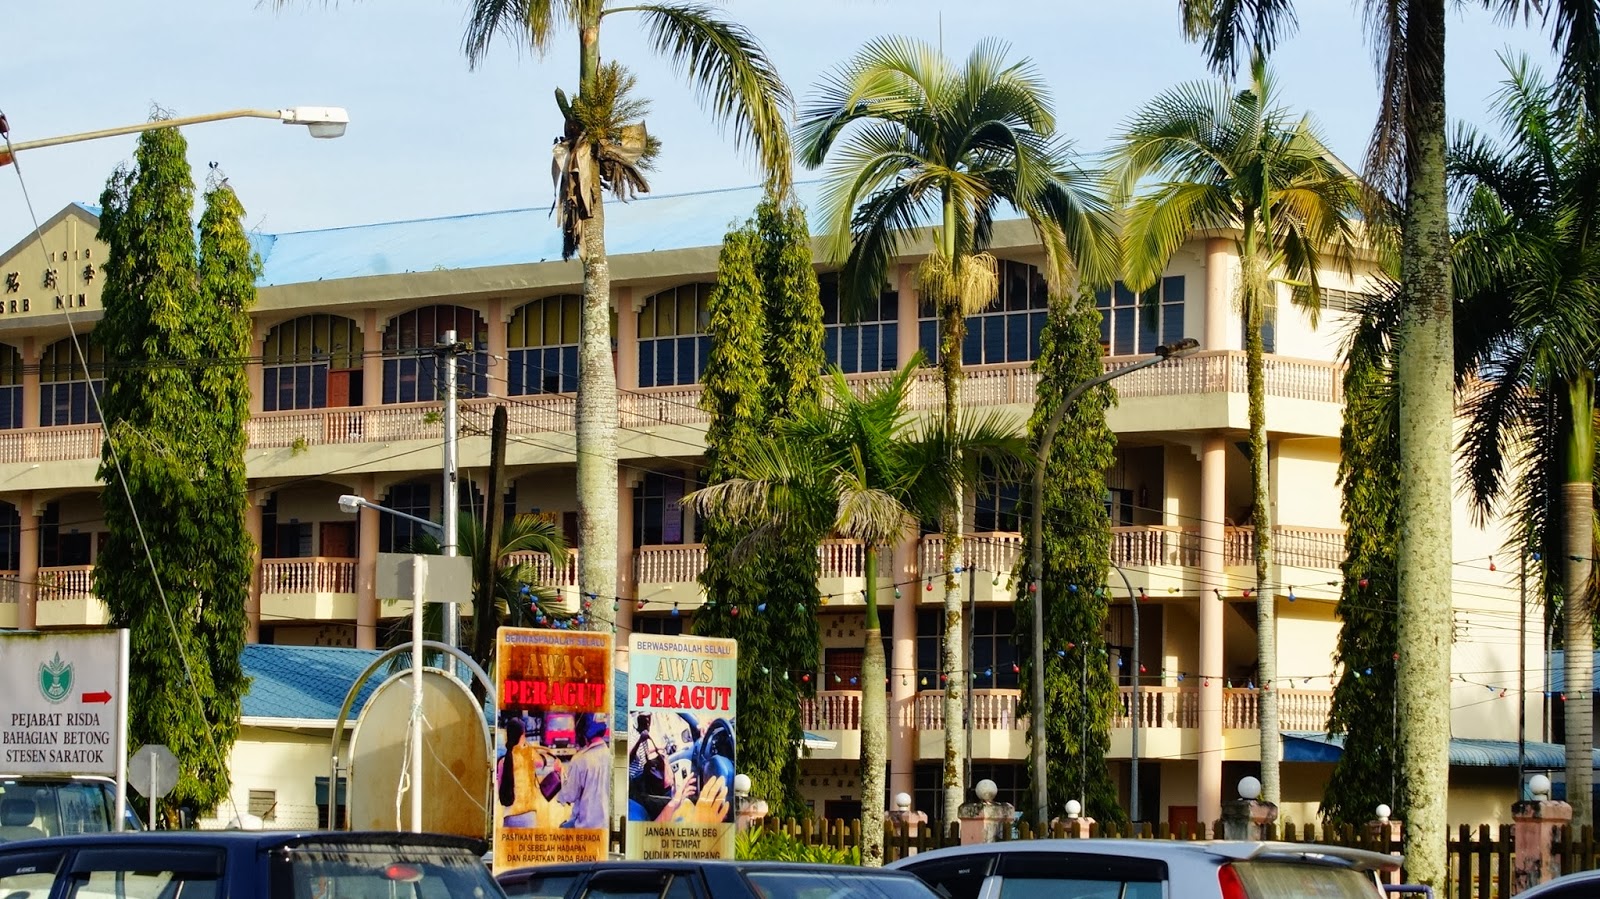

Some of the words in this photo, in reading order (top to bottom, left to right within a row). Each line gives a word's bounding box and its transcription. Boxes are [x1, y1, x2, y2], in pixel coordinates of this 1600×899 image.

[52, 248, 91, 262] 1919
[0, 298, 30, 314] SRB
[505, 634, 574, 646] BERWASPADALAH
[577, 639, 606, 647] SELALU
[637, 641, 702, 653] BERWASPADALAH
[704, 645, 731, 655] SELALU
[525, 653, 586, 678] AWAS
[655, 657, 714, 683] AWAS
[504, 680, 605, 707] PERAGUT
[636, 683, 732, 711] PERAGUT
[11, 713, 62, 728] PEJABAT
[67, 712, 100, 726] RISDA
[3, 731, 58, 745] BAHAGIAN
[63, 731, 110, 745] BETONG
[6, 749, 47, 763] STESEN
[49, 749, 104, 763] SARATOK
[502, 833, 533, 842] PASTIKAN
[549, 834, 574, 842] TANGAN
[576, 834, 601, 842] BERADA
[645, 827, 675, 837] JANGAN
[677, 828, 700, 838] LETAK
[702, 828, 718, 838] BEG
[519, 844, 526, 852] DI
[557, 844, 587, 852] HADAPAN
[661, 839, 669, 848] DI
[671, 839, 702, 849] TEMPAT
[507, 854, 521, 862] DAN
[522, 854, 555, 863] RAPATKAN
[576, 855, 598, 863] BADAN
[643, 850, 671, 860] DUDUK
[673, 851, 721, 860] PENUMPANG
